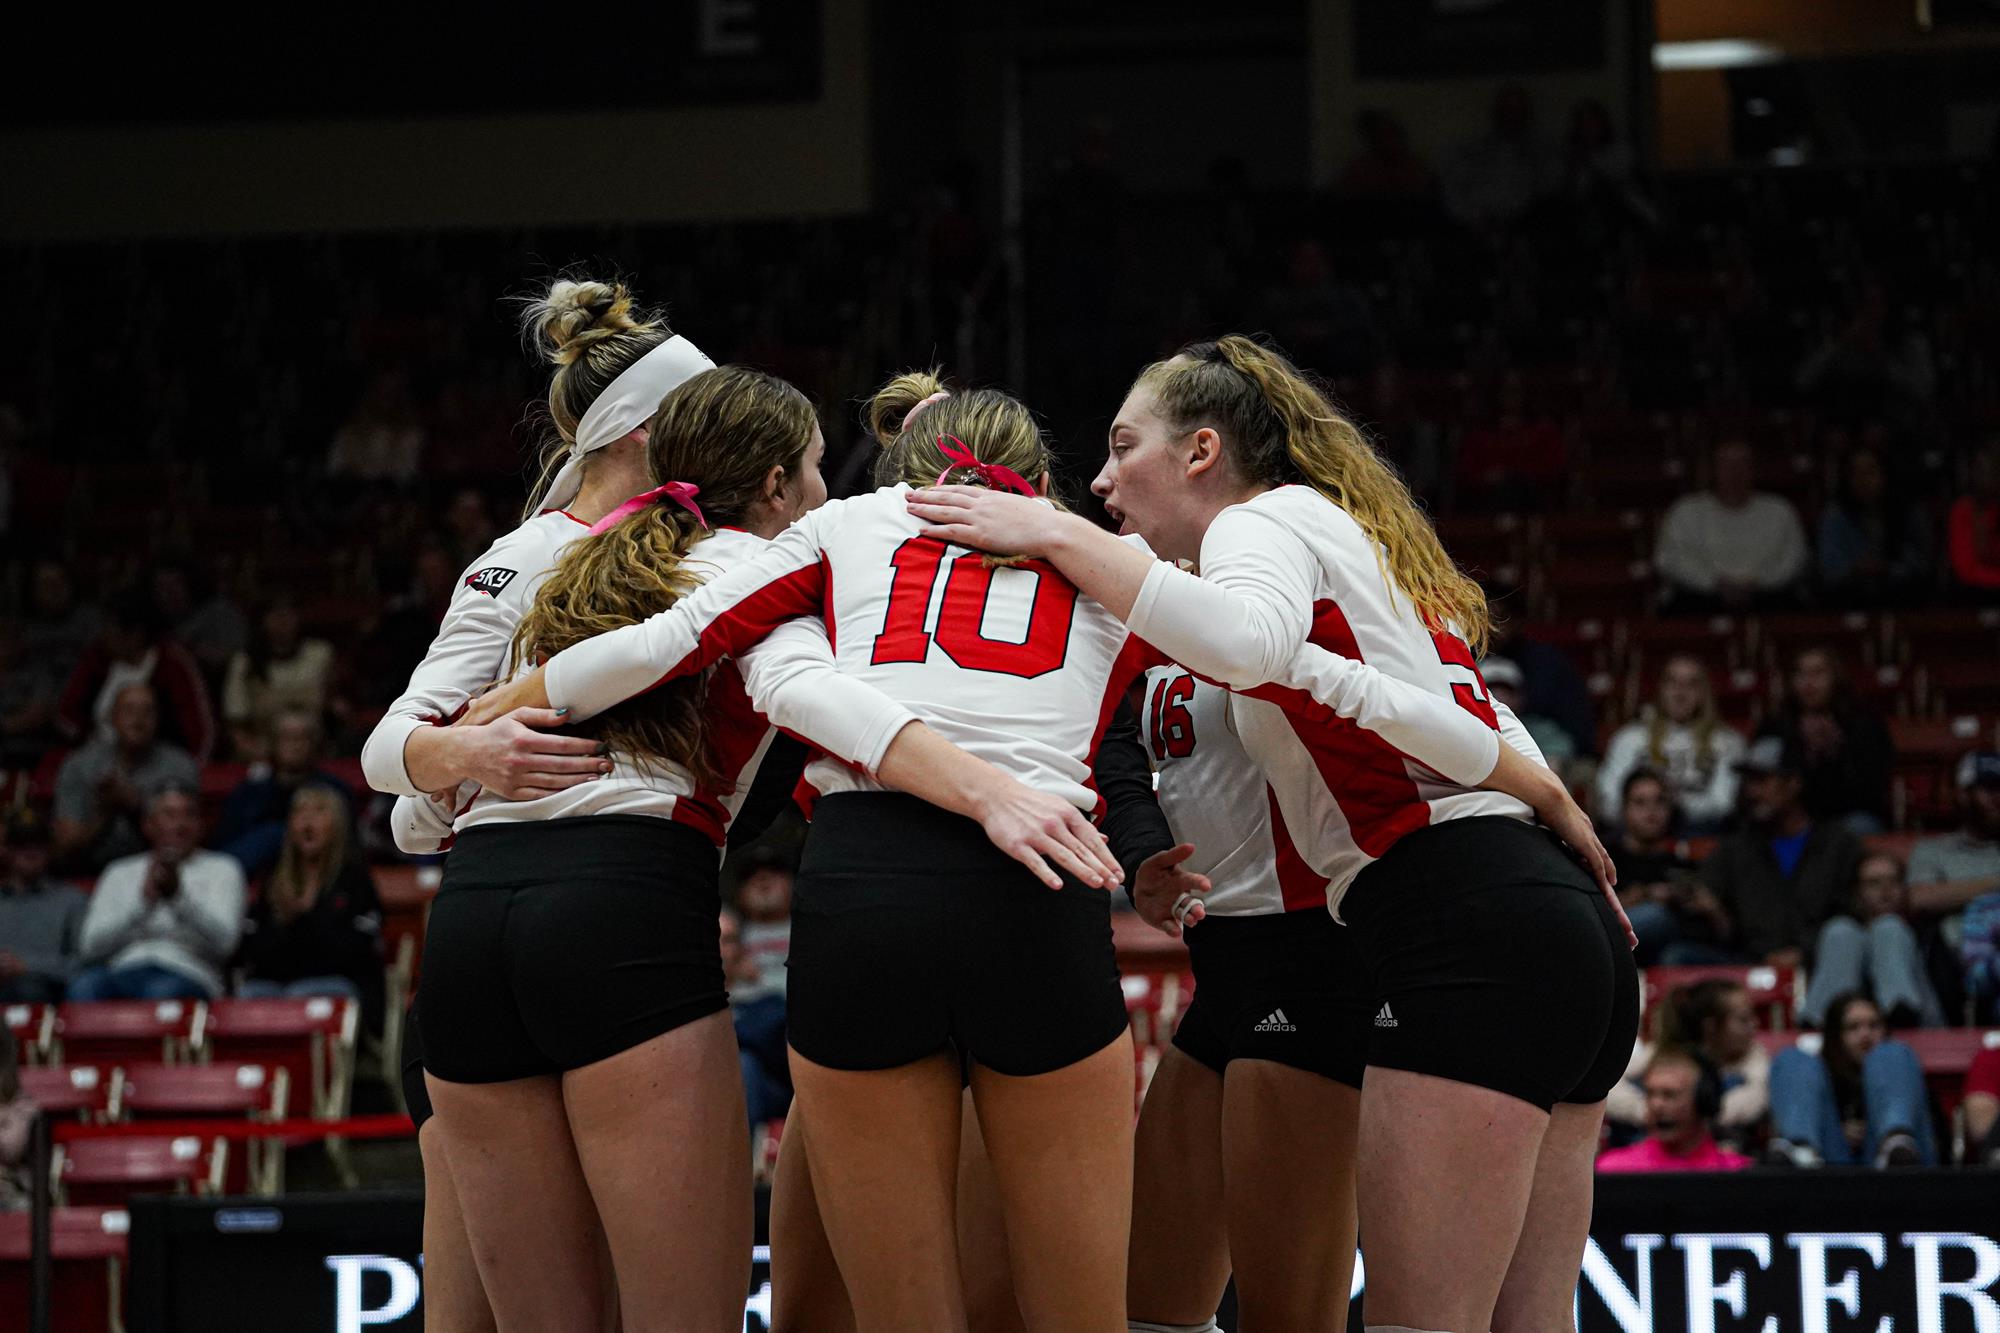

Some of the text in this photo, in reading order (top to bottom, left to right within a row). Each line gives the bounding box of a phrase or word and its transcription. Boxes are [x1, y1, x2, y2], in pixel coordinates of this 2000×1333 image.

[474, 568, 514, 588] SKY
[870, 534, 1079, 680] 10
[1150, 673, 1197, 761] 16
[1254, 1022, 1297, 1032] adidas
[1573, 1232, 2000, 1333] NEER
